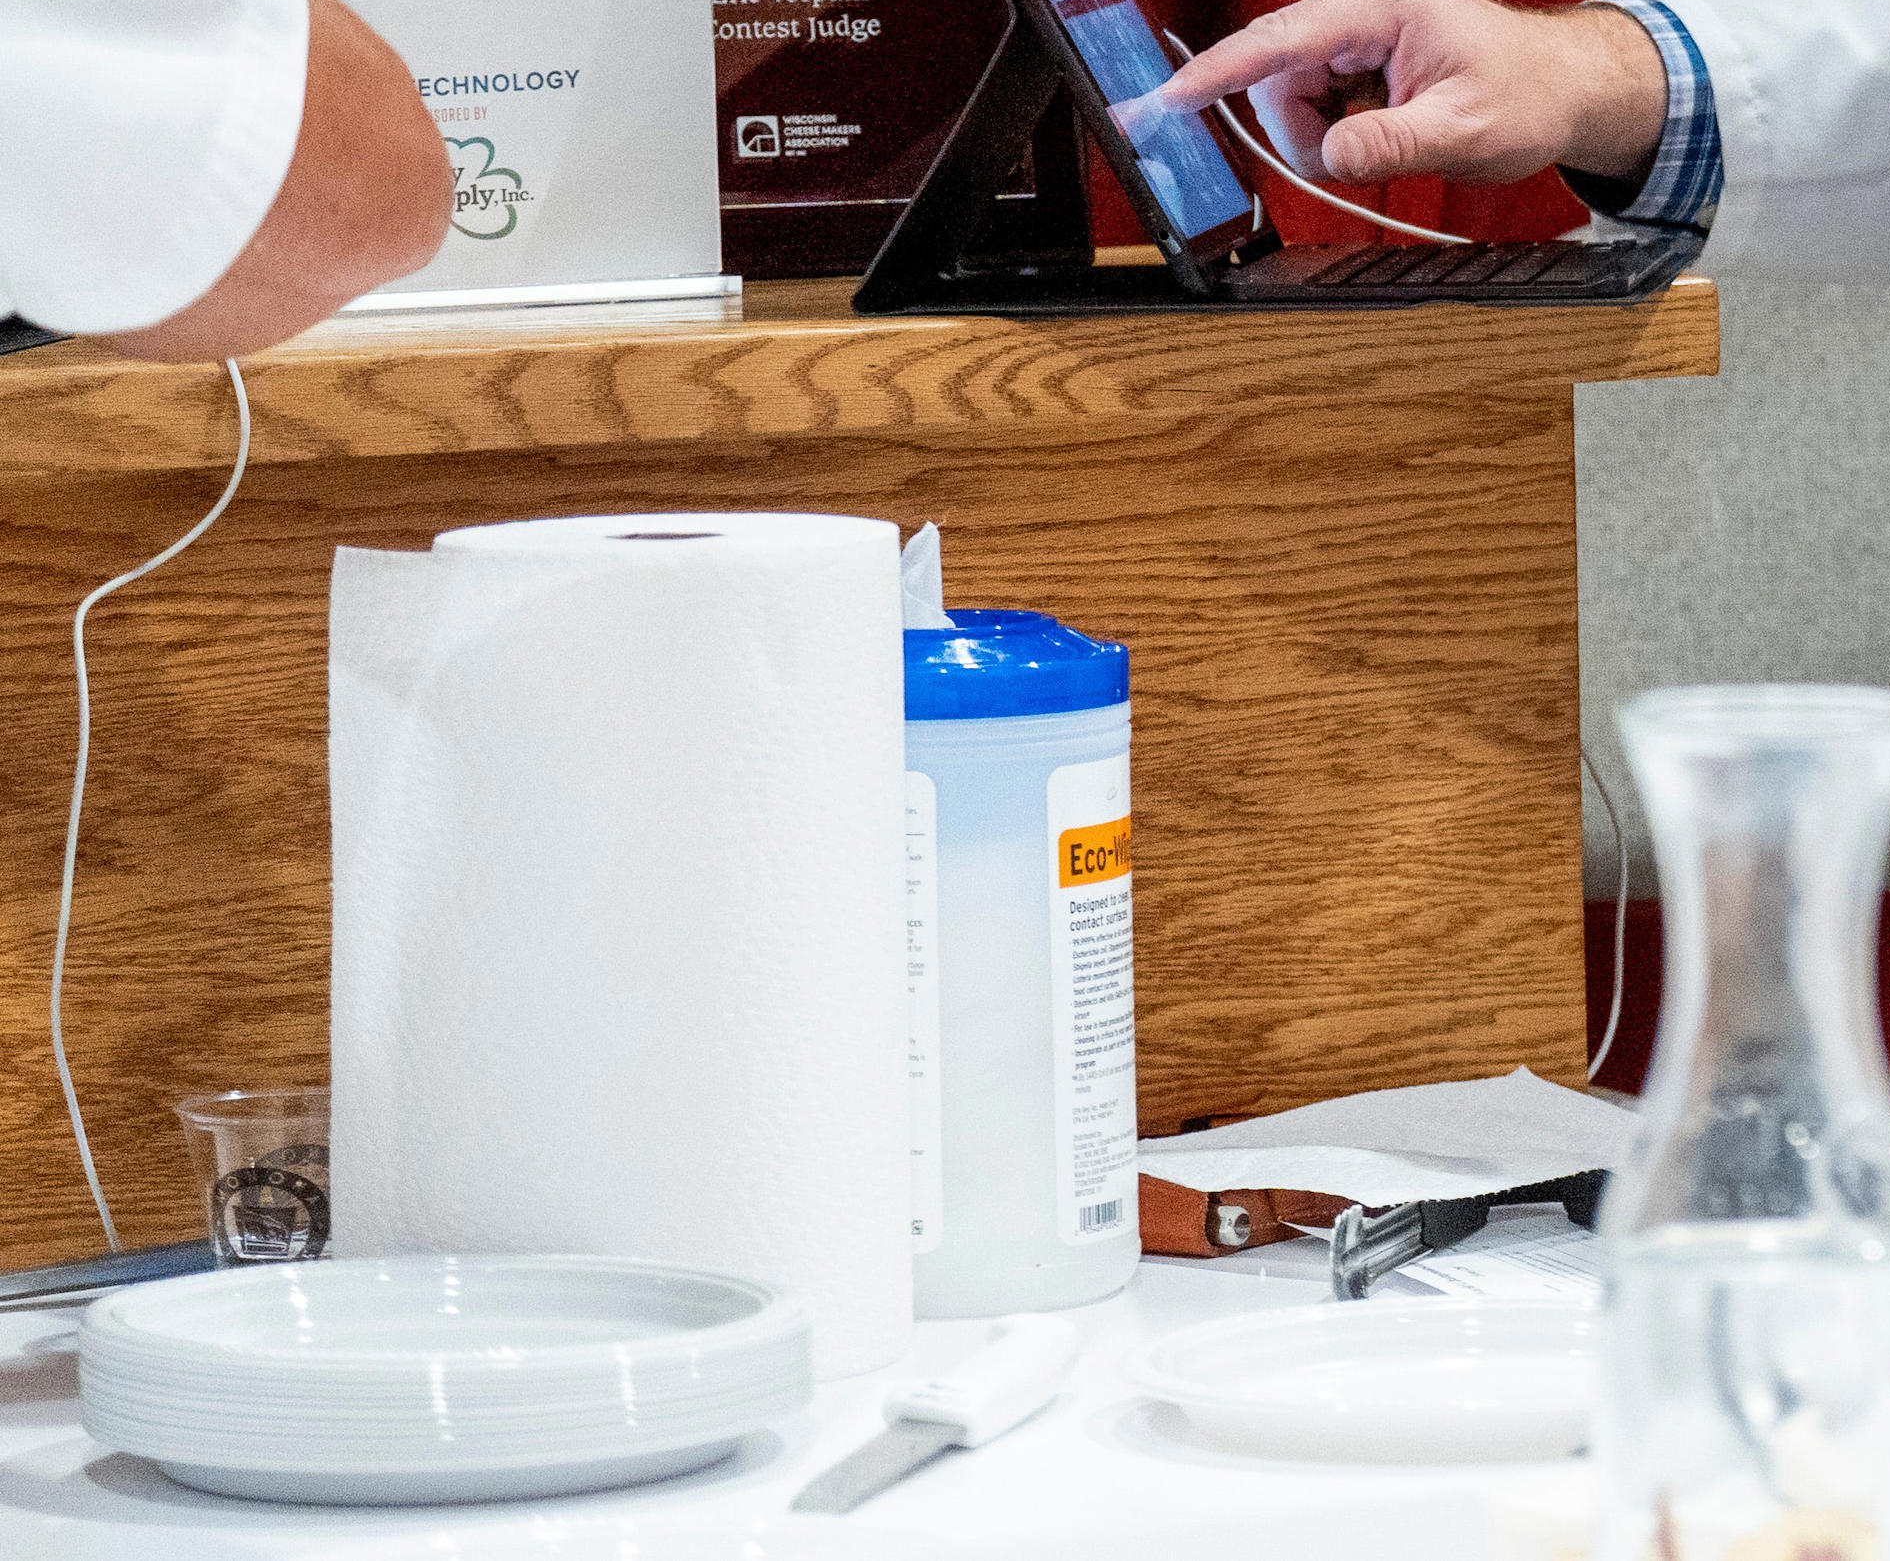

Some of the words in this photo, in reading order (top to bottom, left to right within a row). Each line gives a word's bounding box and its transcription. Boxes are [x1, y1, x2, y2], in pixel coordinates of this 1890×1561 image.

[808, 14, 881, 43] Judge
[415, 69, 580, 97] ECHNOLOGY
[433, 107, 470, 123] SORED
[474, 106, 488, 120] BY
[456, 184, 498, 212] ply,
[501, 188, 534, 202] Inc.
[1069, 895, 1109, 914] Designed
[1069, 914, 1104, 932] contact
